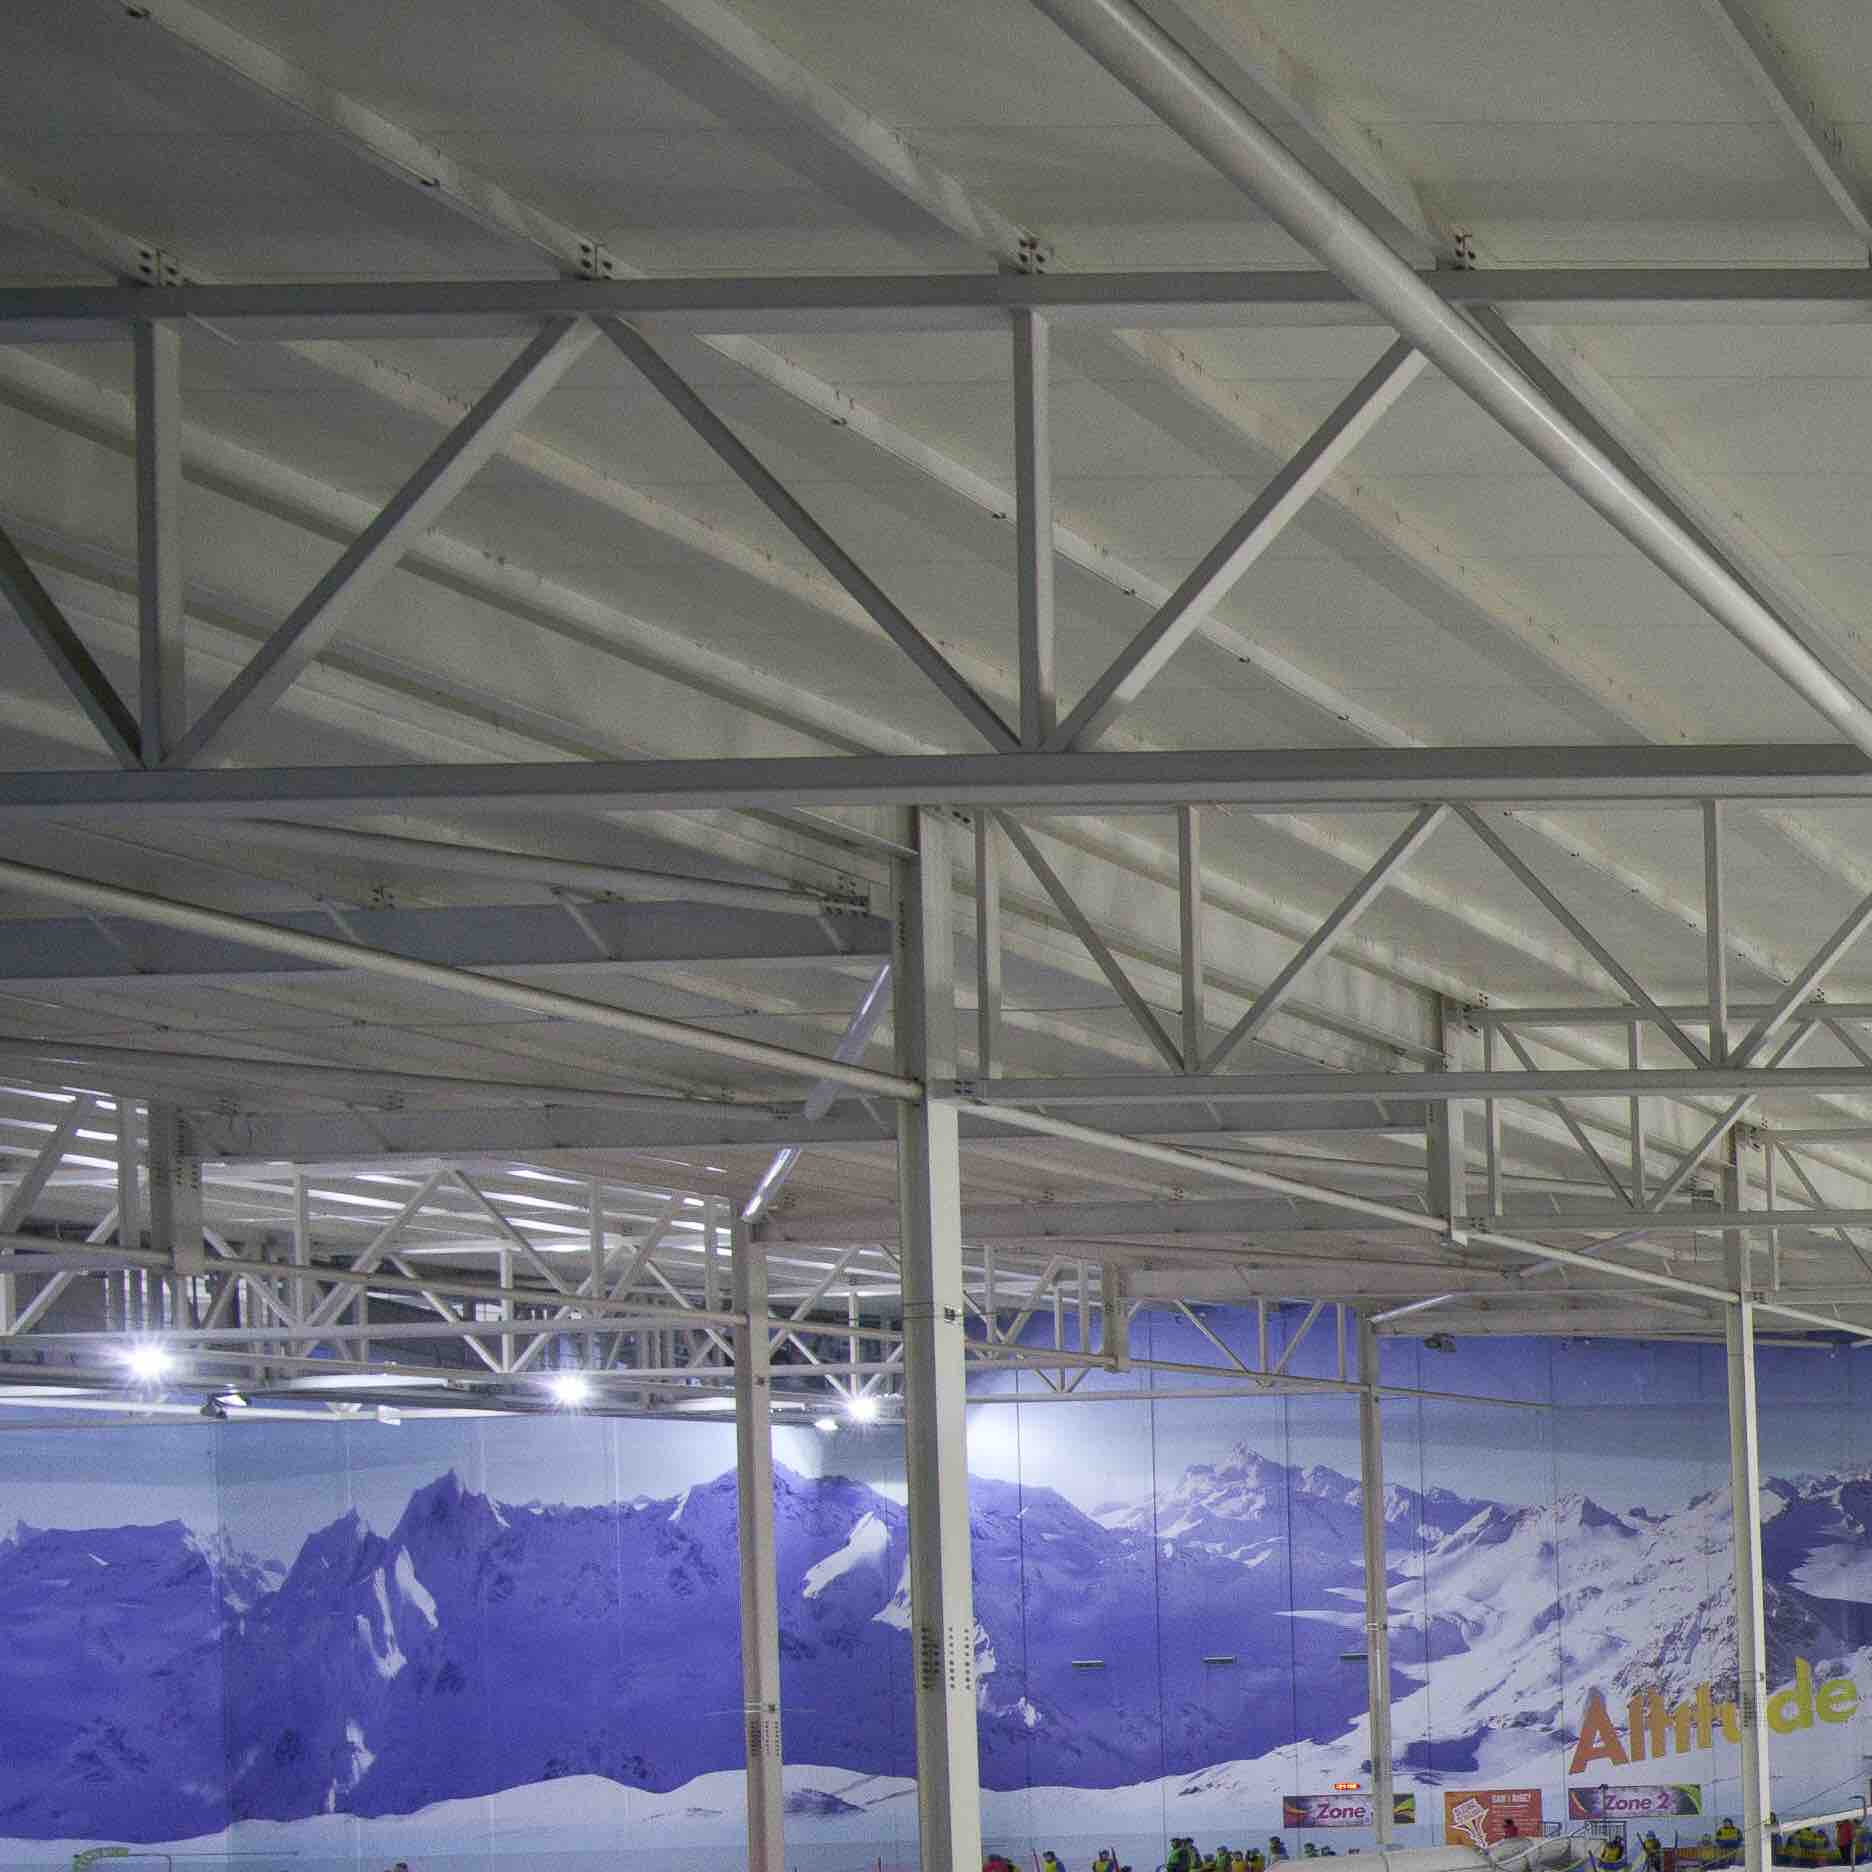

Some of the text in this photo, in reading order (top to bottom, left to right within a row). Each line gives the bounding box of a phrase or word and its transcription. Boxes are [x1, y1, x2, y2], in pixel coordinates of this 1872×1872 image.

[1606, 1793, 1671, 1811] Zone 2
[1317, 1803, 1366, 1819] Zone
